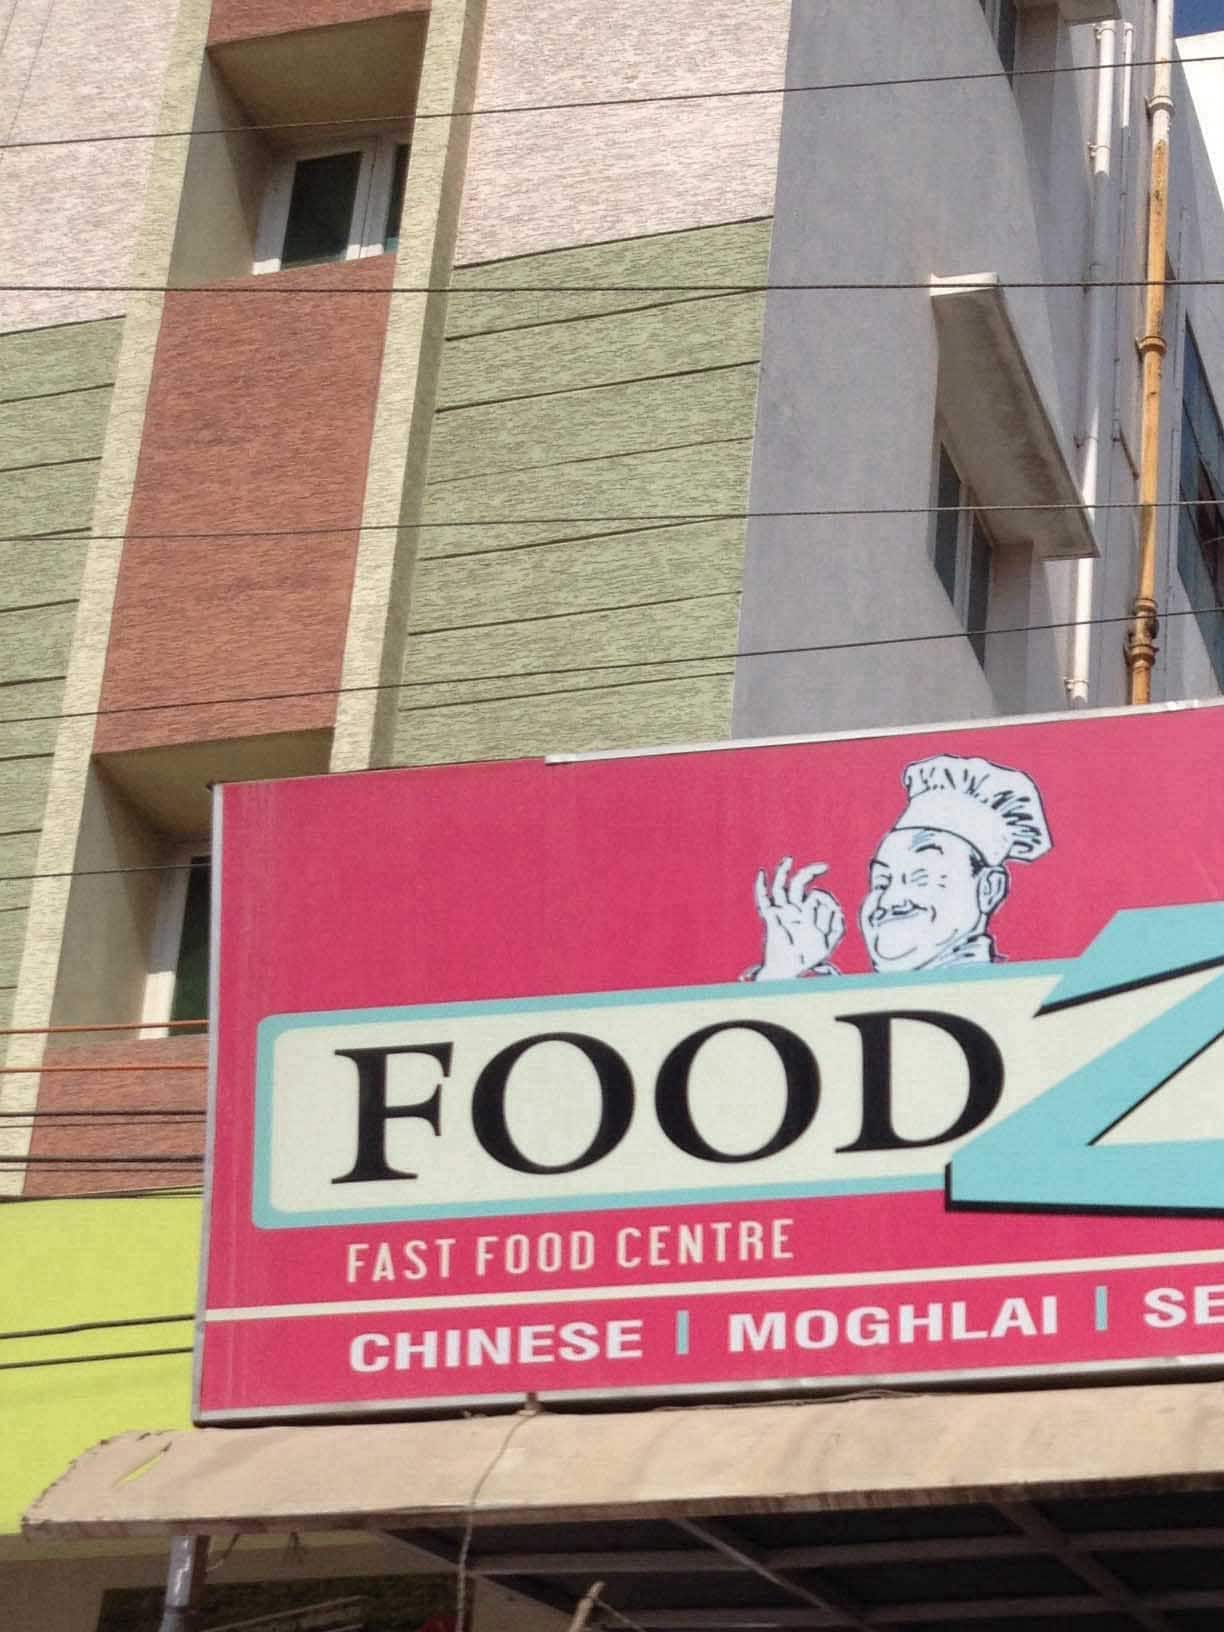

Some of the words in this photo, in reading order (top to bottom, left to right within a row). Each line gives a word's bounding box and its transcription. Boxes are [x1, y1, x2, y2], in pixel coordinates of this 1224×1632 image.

[331, 1009, 1005, 1185] FOOD
[346, 1236, 456, 1285] FAST
[475, 1229, 596, 1278] FOOD
[617, 1217, 795, 1270] CENTRE
[348, 1318, 644, 1374] CHINESE
[727, 1295, 1058, 1354] MOGHLAI
